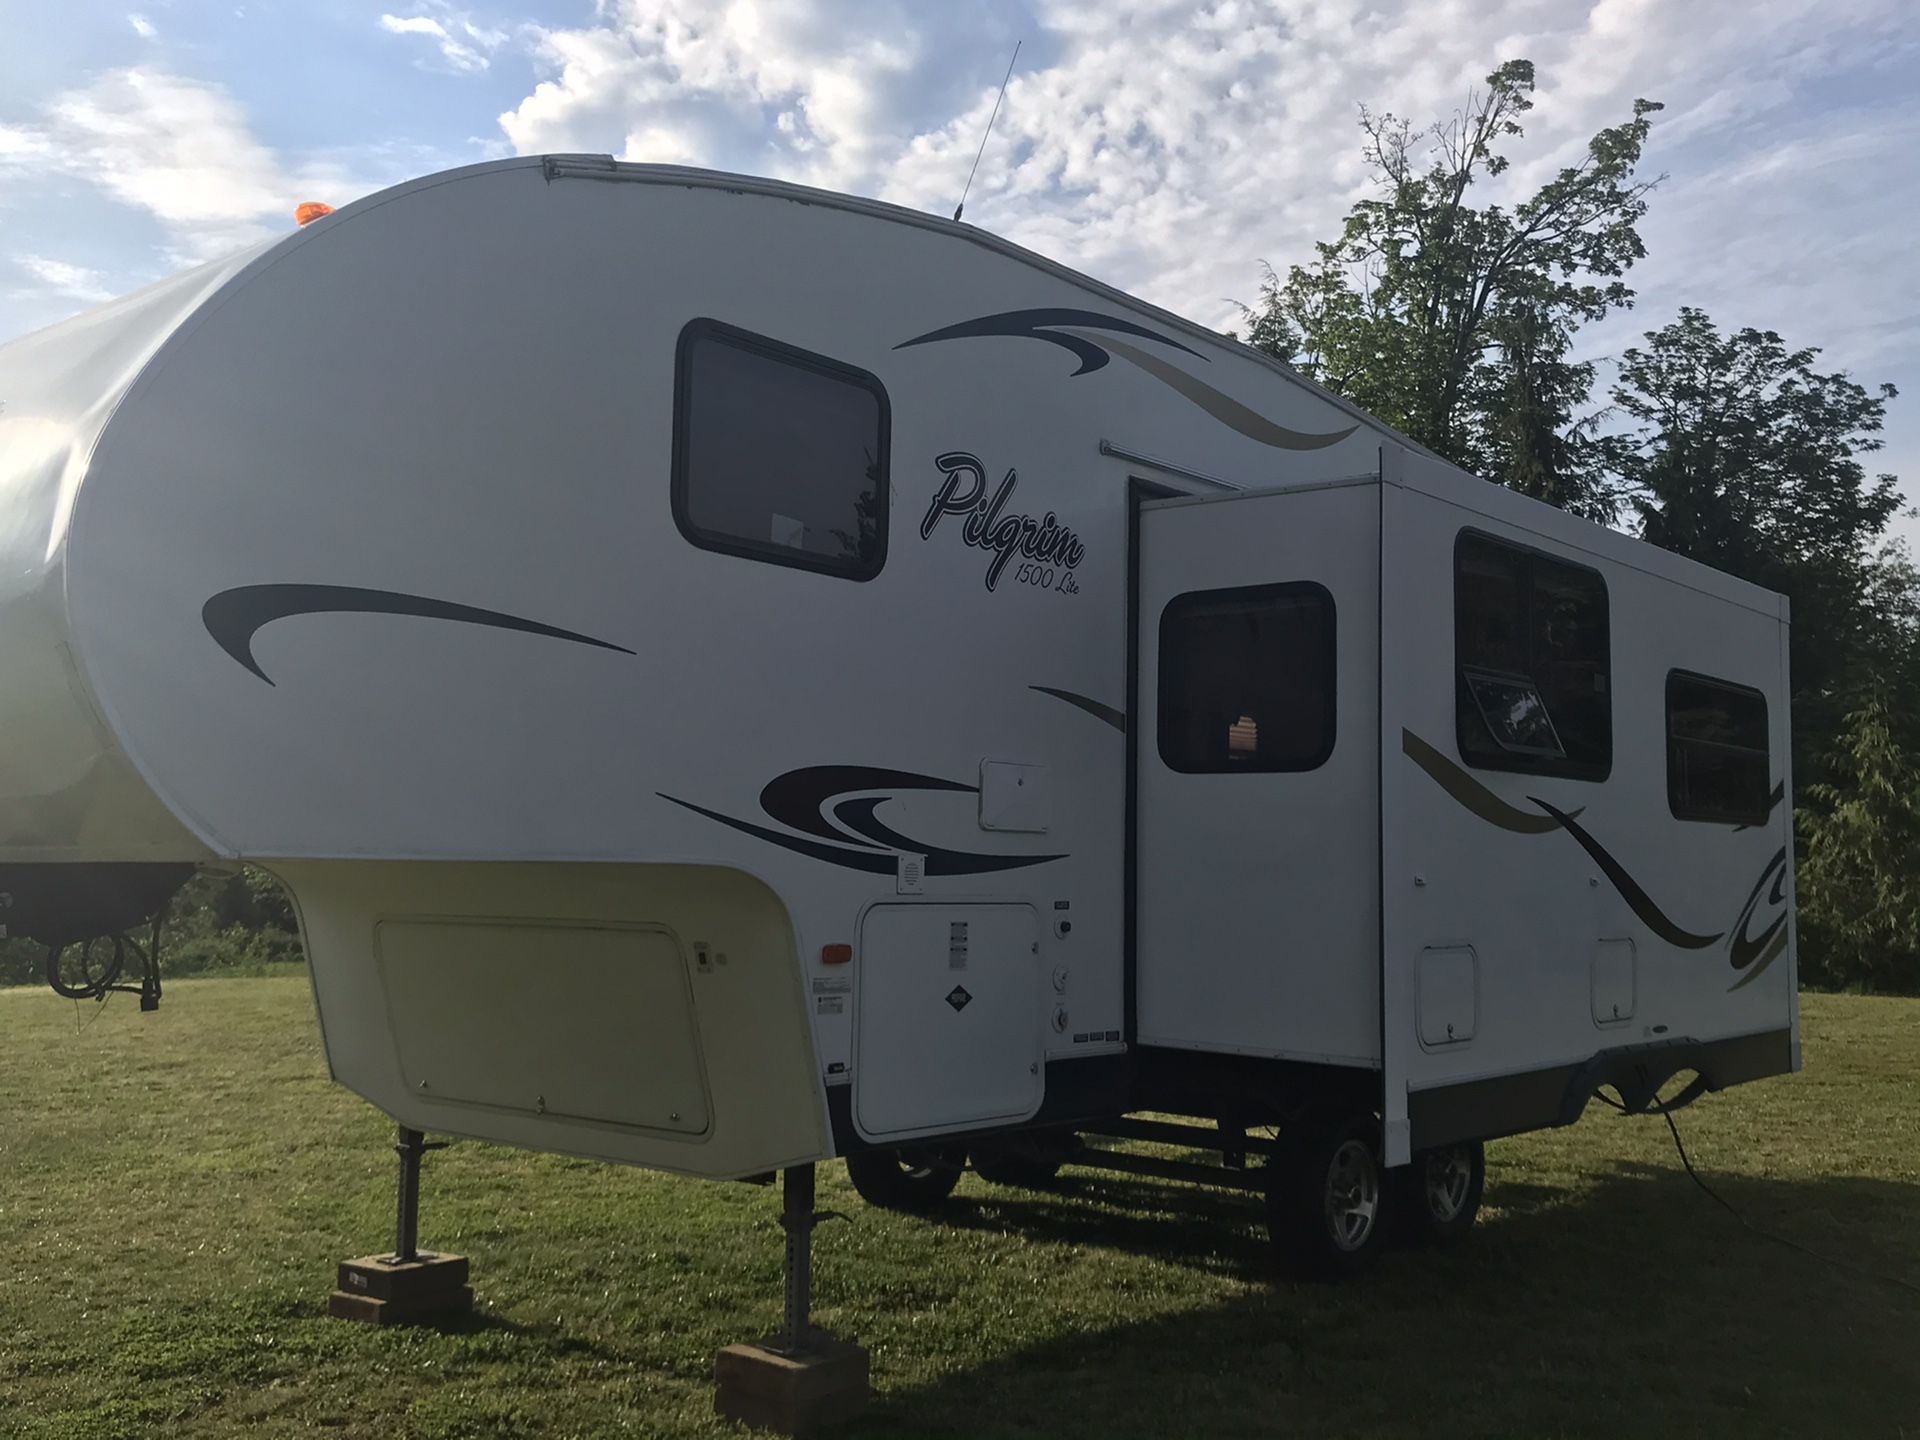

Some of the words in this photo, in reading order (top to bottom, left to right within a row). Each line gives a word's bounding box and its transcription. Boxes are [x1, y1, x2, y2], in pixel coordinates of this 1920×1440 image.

[921, 452, 1085, 593] Pilgrim
[1014, 563, 1054, 588] 1500
[1055, 572, 1080, 594] Lite
